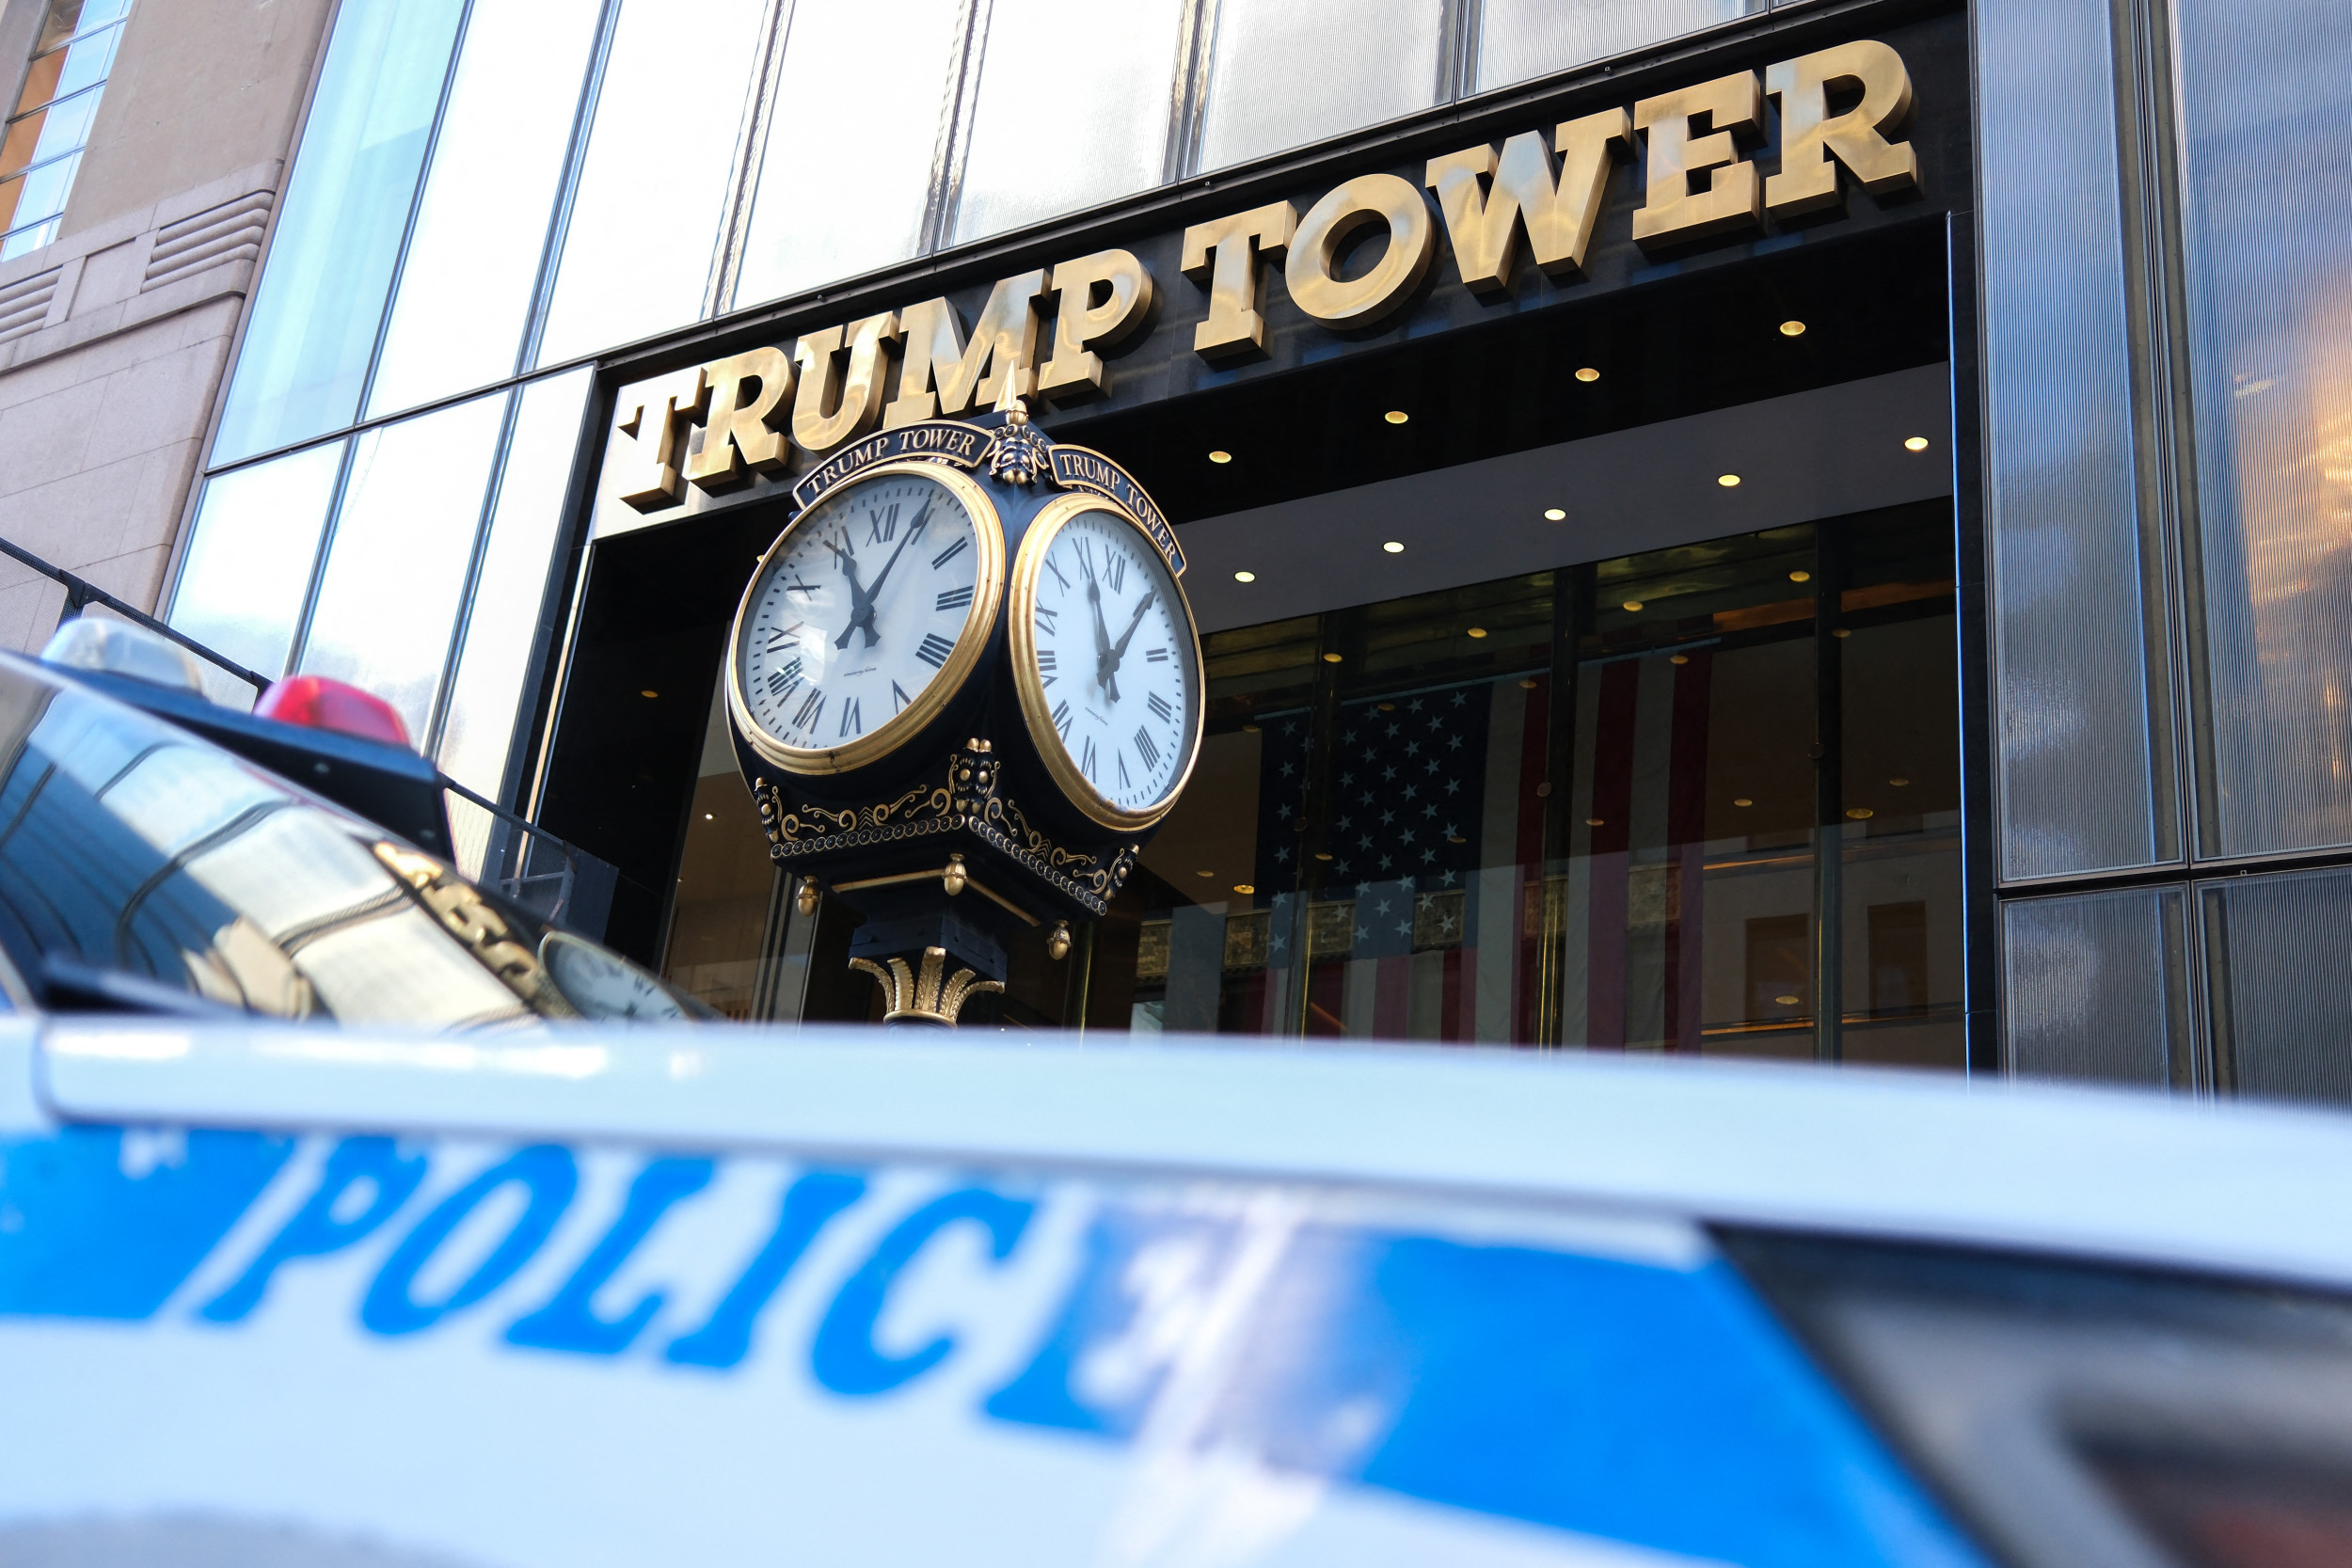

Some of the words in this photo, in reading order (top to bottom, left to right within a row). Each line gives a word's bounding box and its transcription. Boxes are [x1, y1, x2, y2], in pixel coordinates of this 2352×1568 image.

[615, 248, 1153, 513] TRUMP
[1180, 40, 1917, 361] TOWER
[806, 436, 889, 495] TRUMP
[898, 428, 976, 456] TOWER
[865, 502, 900, 547] XII
[1059, 454, 1120, 491] TRUMP
[1125, 483, 1176, 563] TOWER
[931, 536, 968, 570] II
[1102, 543, 1126, 594] XII
[935, 585, 974, 611] III
[1145, 647, 1169, 663] II
[1147, 690, 1172, 724] III
[1134, 724, 1161, 773] IIII
[193, 1132, 1251, 1441] POLICE
